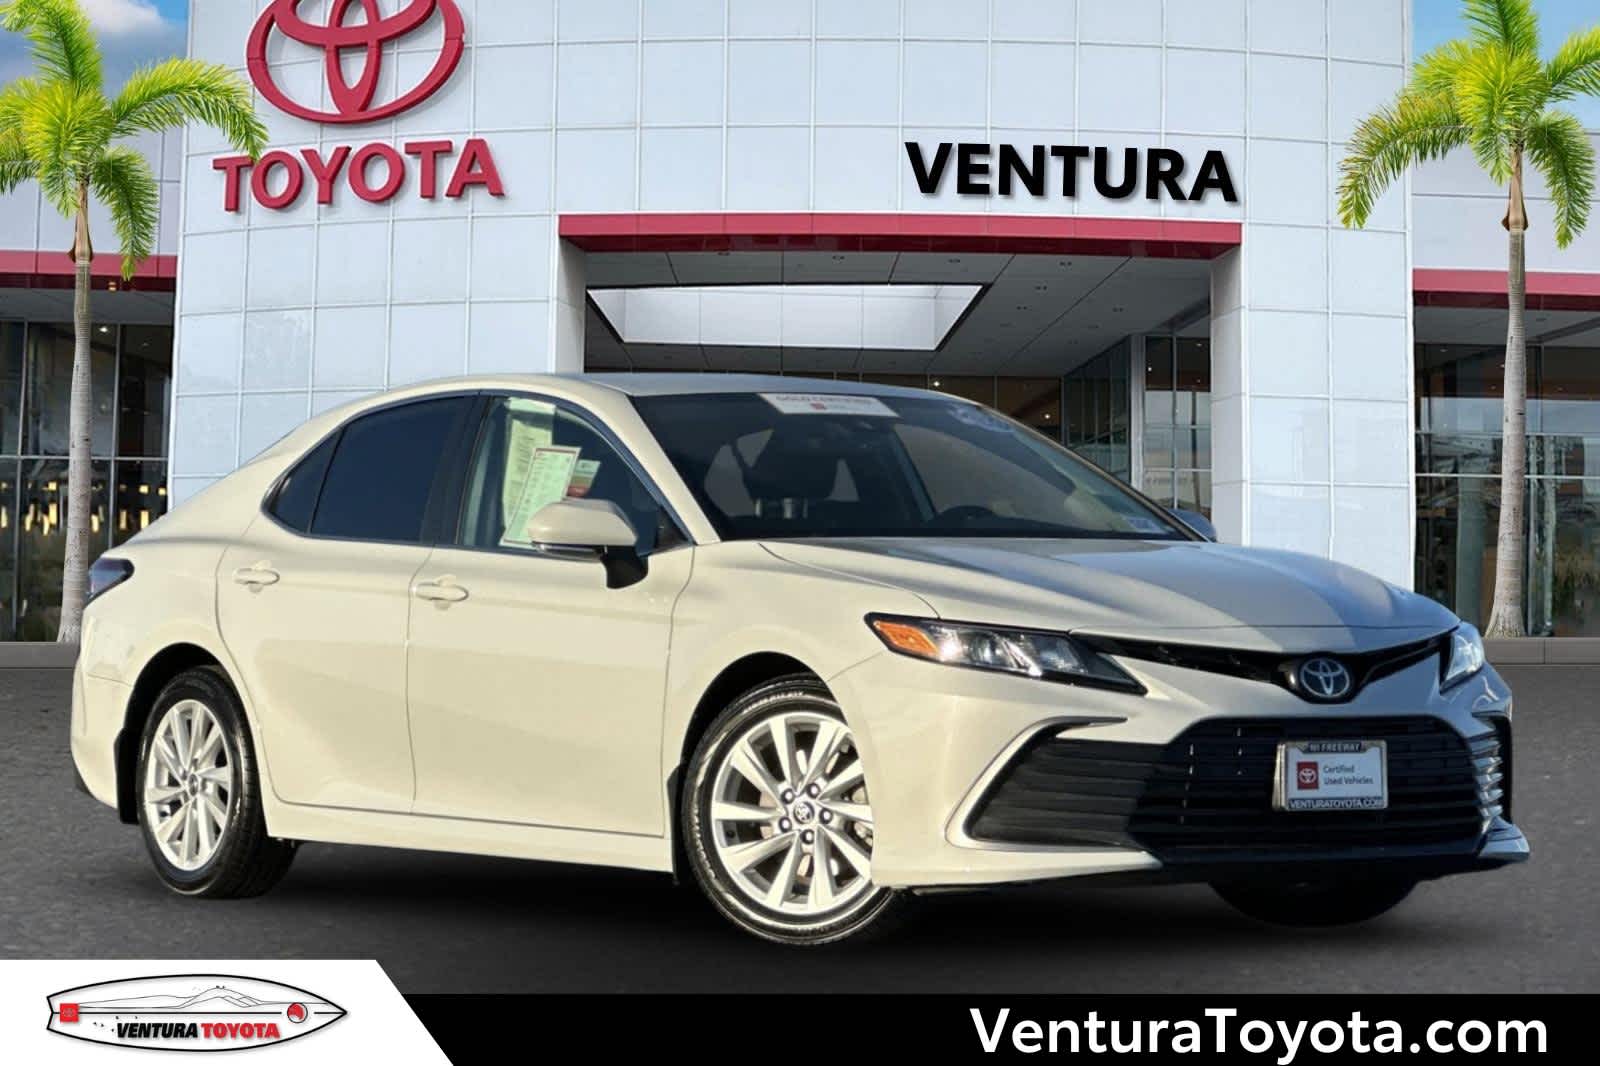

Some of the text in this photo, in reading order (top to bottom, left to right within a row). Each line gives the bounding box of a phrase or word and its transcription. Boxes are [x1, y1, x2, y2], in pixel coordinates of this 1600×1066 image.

[212, 138, 505, 212] TOYOTA
[904, 141, 1239, 203] VENTURA
[1321, 743, 1360, 752] FREEWAY
[1323, 764, 1354, 773] Certified
[1323, 776, 1374, 785] Used Vehicles
